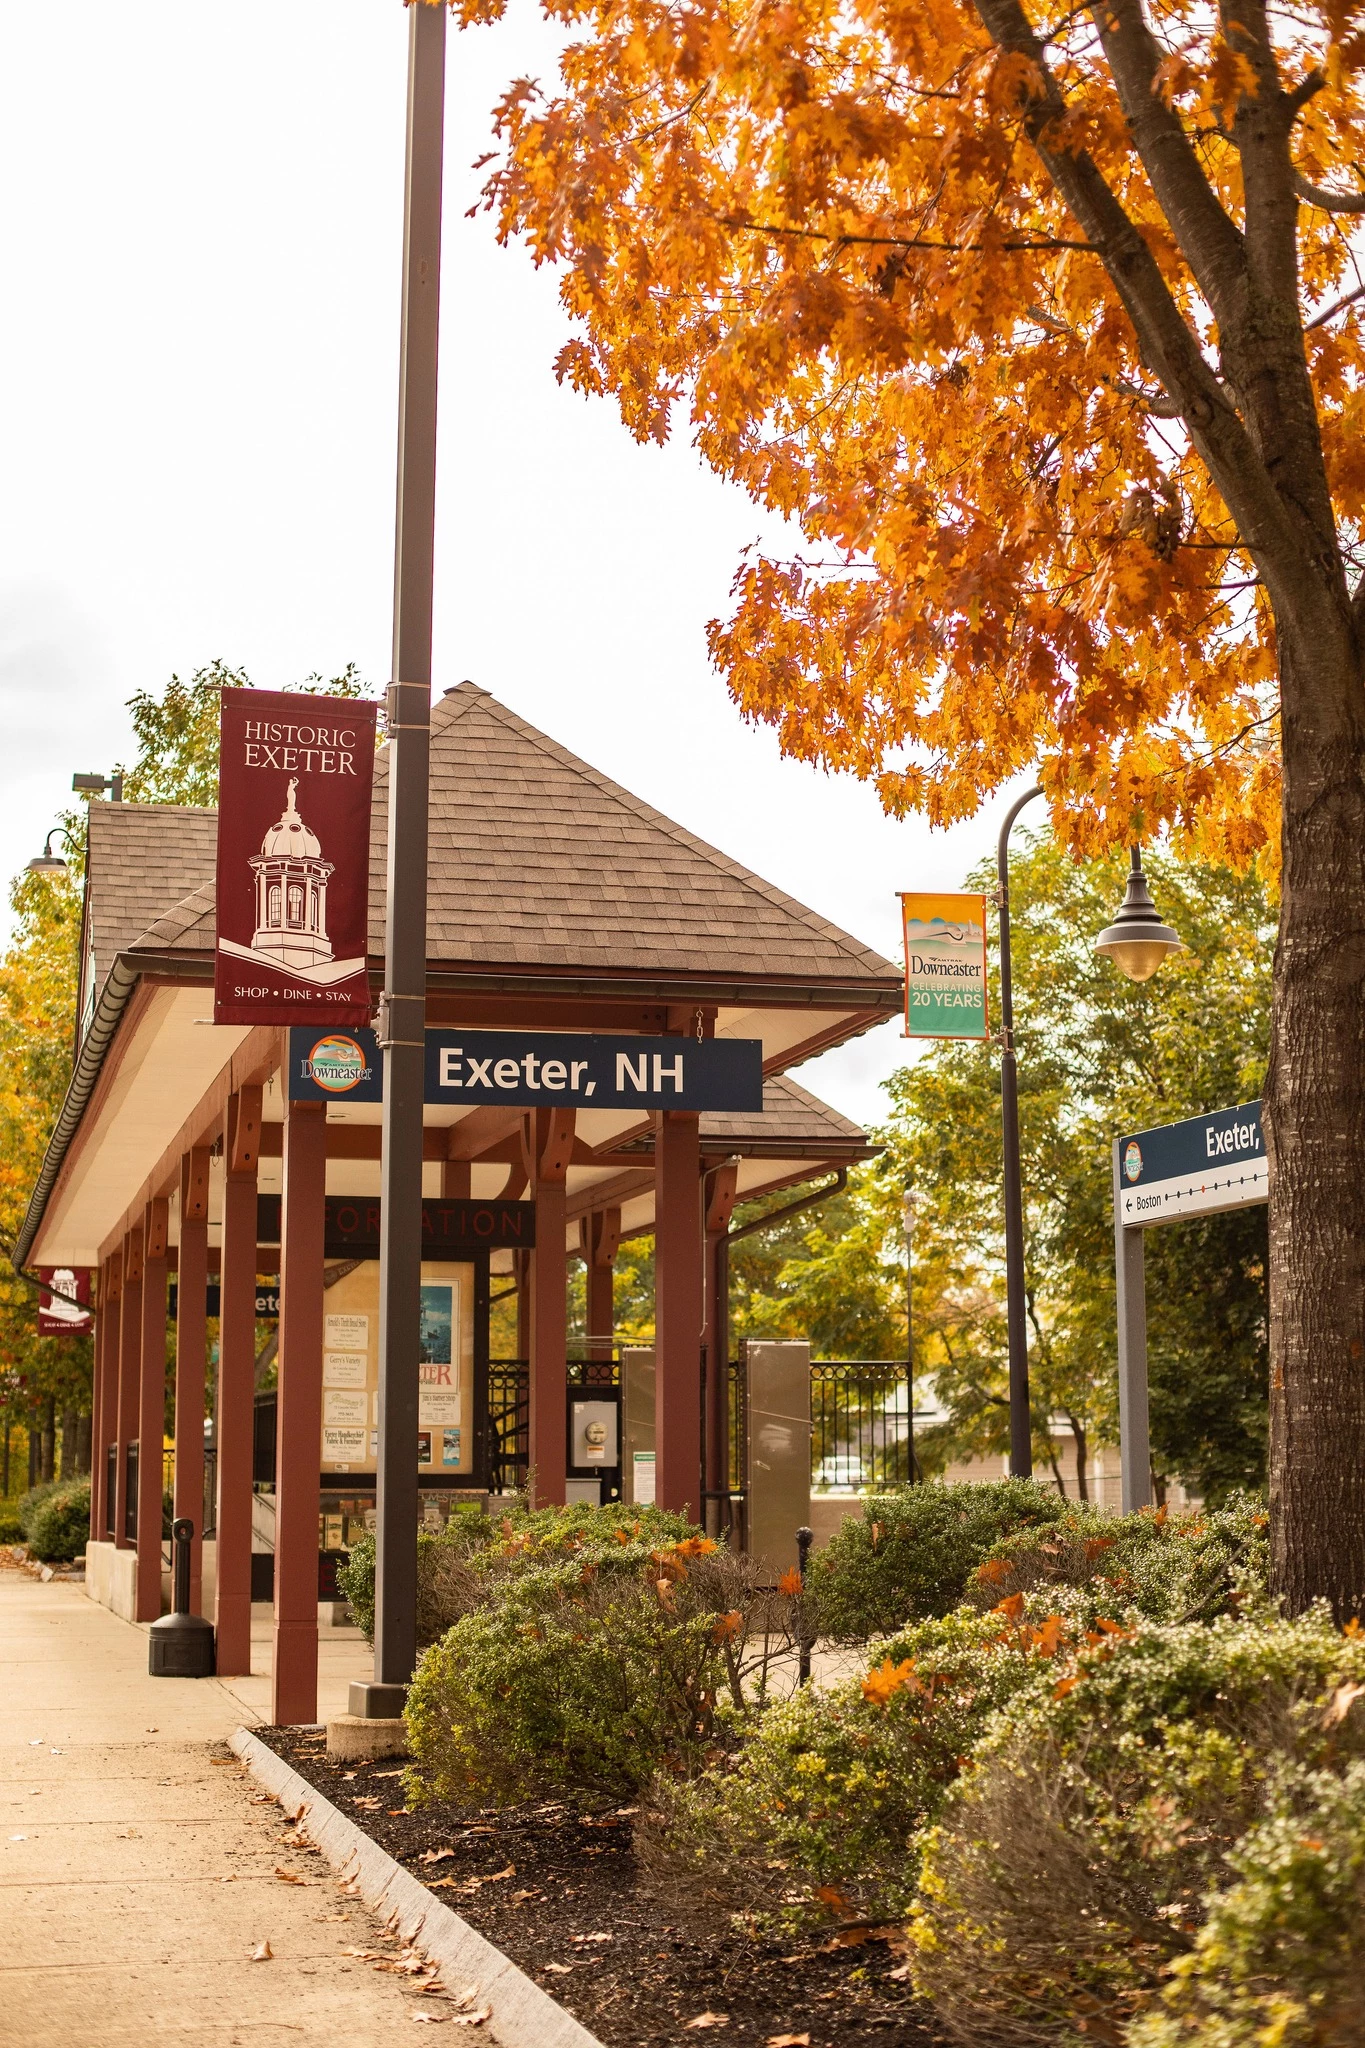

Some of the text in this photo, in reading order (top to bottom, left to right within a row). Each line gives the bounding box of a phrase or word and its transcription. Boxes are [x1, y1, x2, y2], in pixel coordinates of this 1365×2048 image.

[245, 720, 356, 748] HISTORIC
[244, 743, 357, 775] EXETER
[911, 955, 982, 977] Downeaster
[234, 986, 352, 1002] SHOP DINE STAY
[912, 981, 981, 993] CELEBRATING
[912, 991, 982, 1008] 20 YEARS
[301, 1060, 372, 1080] Downeaster
[439, 1047, 684, 1096] Exeter, NH
[1206, 1122, 1260, 1158] Exeter,
[1136, 1194, 1162, 1211] Boston
